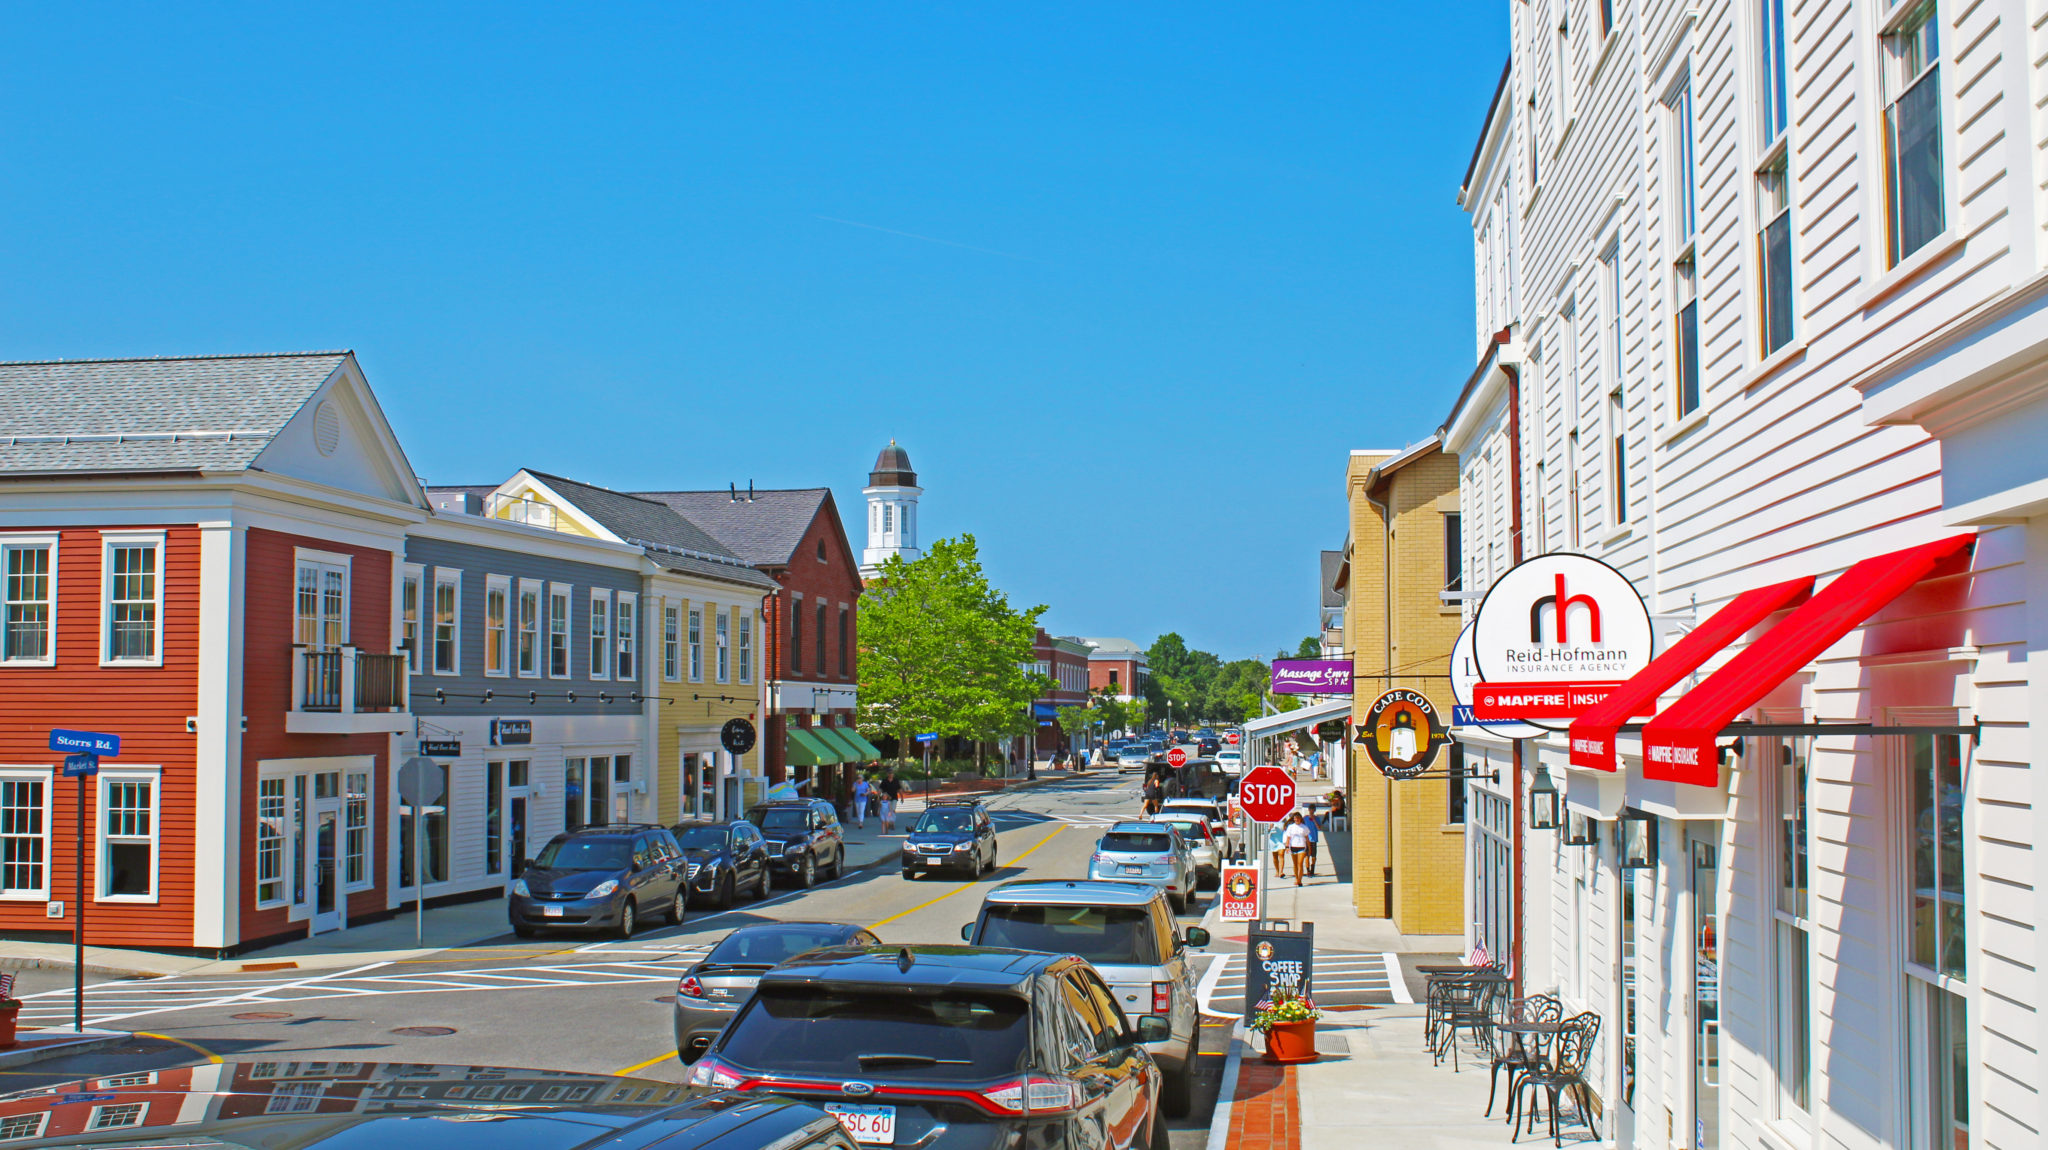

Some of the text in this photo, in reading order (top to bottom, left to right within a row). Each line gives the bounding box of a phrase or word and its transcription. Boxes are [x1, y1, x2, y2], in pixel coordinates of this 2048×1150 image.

[1506, 649, 1628, 663] Reid-Hofmann
[1275, 668, 1350, 682] Massage Envy
[1507, 665, 1574, 673] INSURANCE
[1373, 691, 1432, 714] CAPE COD
[1498, 694, 1609, 706] MAPFRE INSU
[56, 735, 113, 750] Storrs Rd.
[1431, 732, 1445, 740] 1970
[1574, 739, 1604, 755] MAPFRE INSURANCE
[1168, 753, 1186, 762] STOP
[1651, 745, 1699, 766] MAPFRE INSURANCE
[1243, 783, 1292, 805] STOP
[1225, 902, 1254, 910] COLD
[1225, 909, 1254, 917] BREW
[1262, 961, 1304, 973] COFFEE
[1269, 972, 1301, 987] SHOP
[871, 1114, 891, 1133] 60
